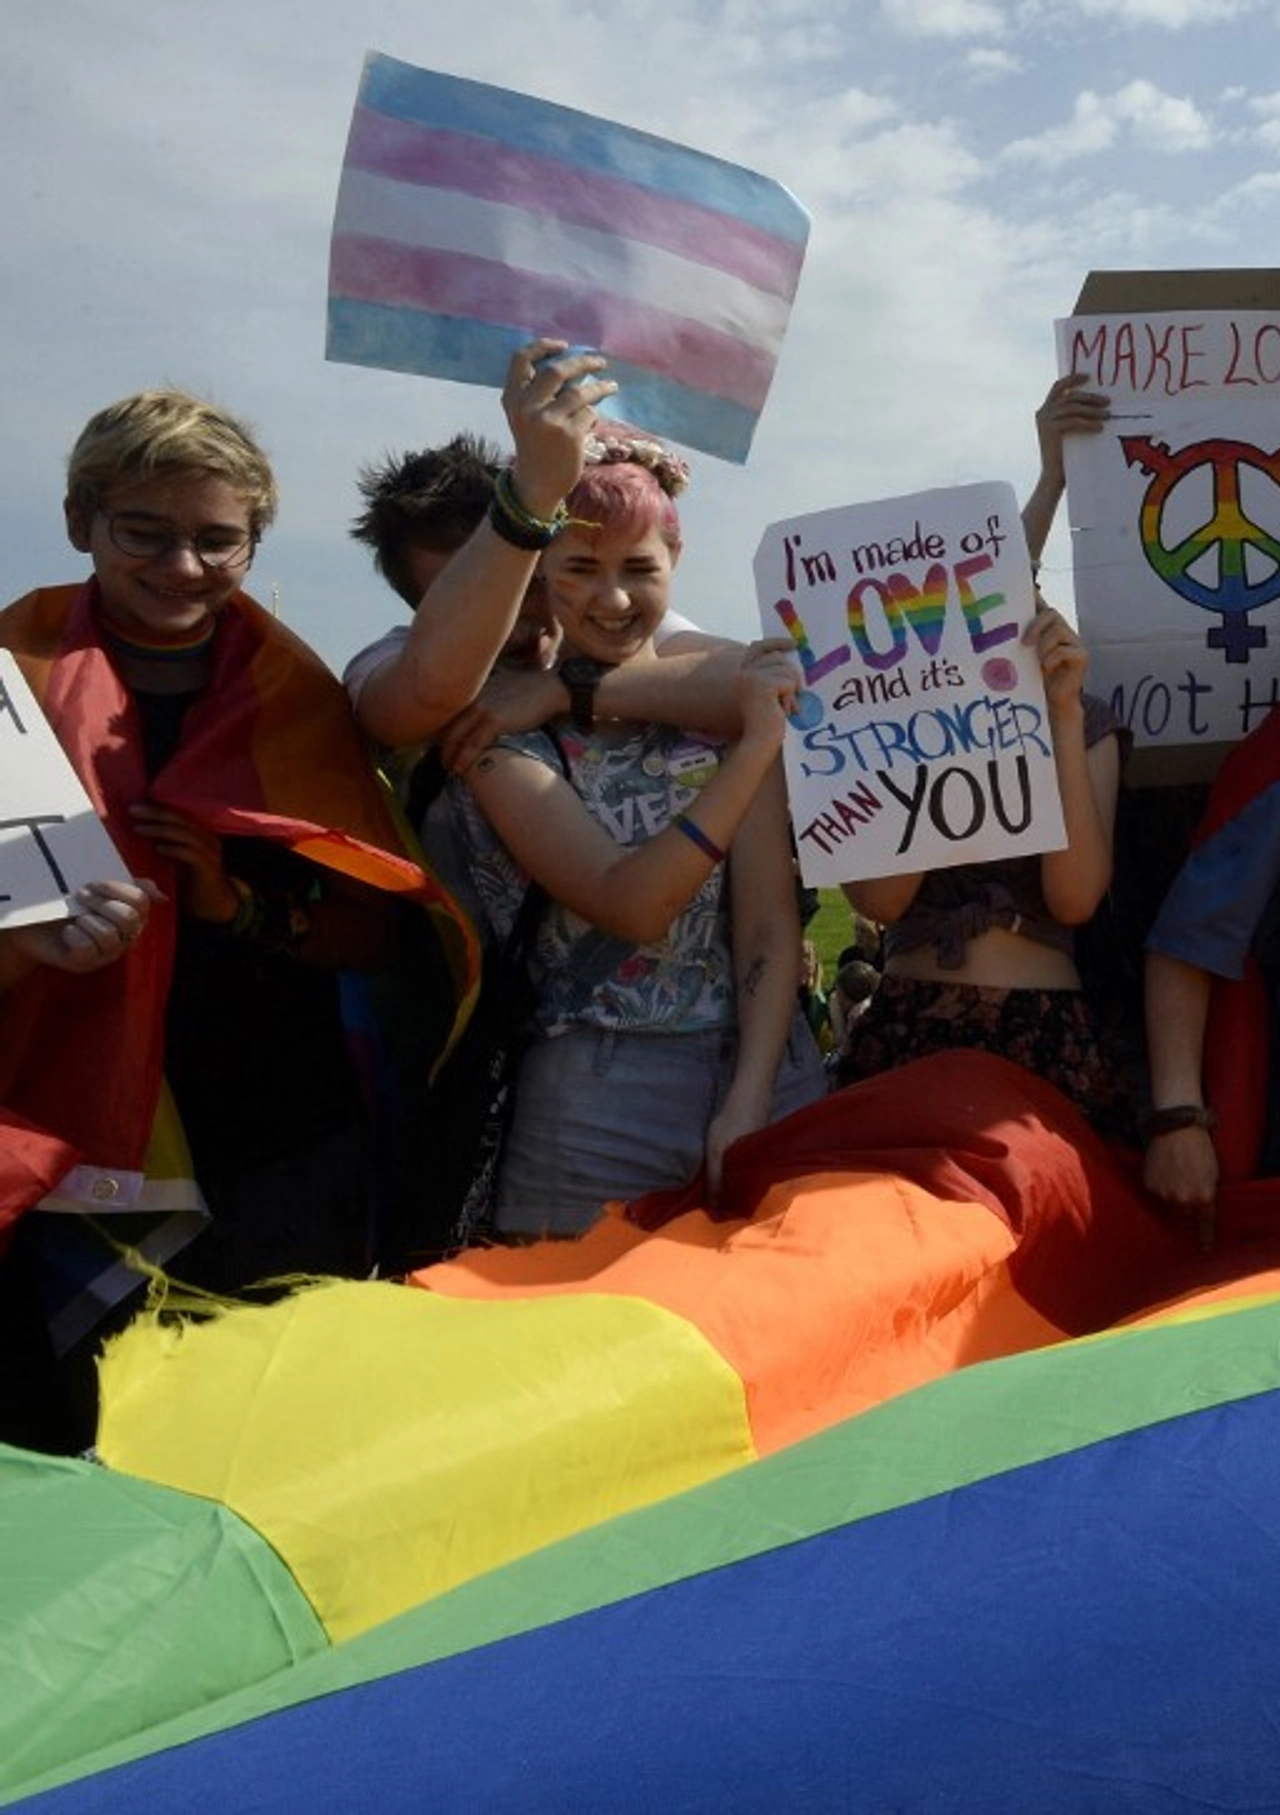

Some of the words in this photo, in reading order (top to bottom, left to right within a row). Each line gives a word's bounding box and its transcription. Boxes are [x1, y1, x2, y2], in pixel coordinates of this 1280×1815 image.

[1070, 322, 1206, 396] MAKE
[784, 534, 837, 592] I'm
[852, 520, 946, 574] made
[960, 515, 1007, 557] of
[774, 554, 1019, 686] LOVE
[833, 673, 912, 711] and
[920, 659, 965, 691] it's
[800, 696, 1051, 777] STRONGER
[798, 781, 884, 854] THAN
[876, 755, 1032, 855] YOU
